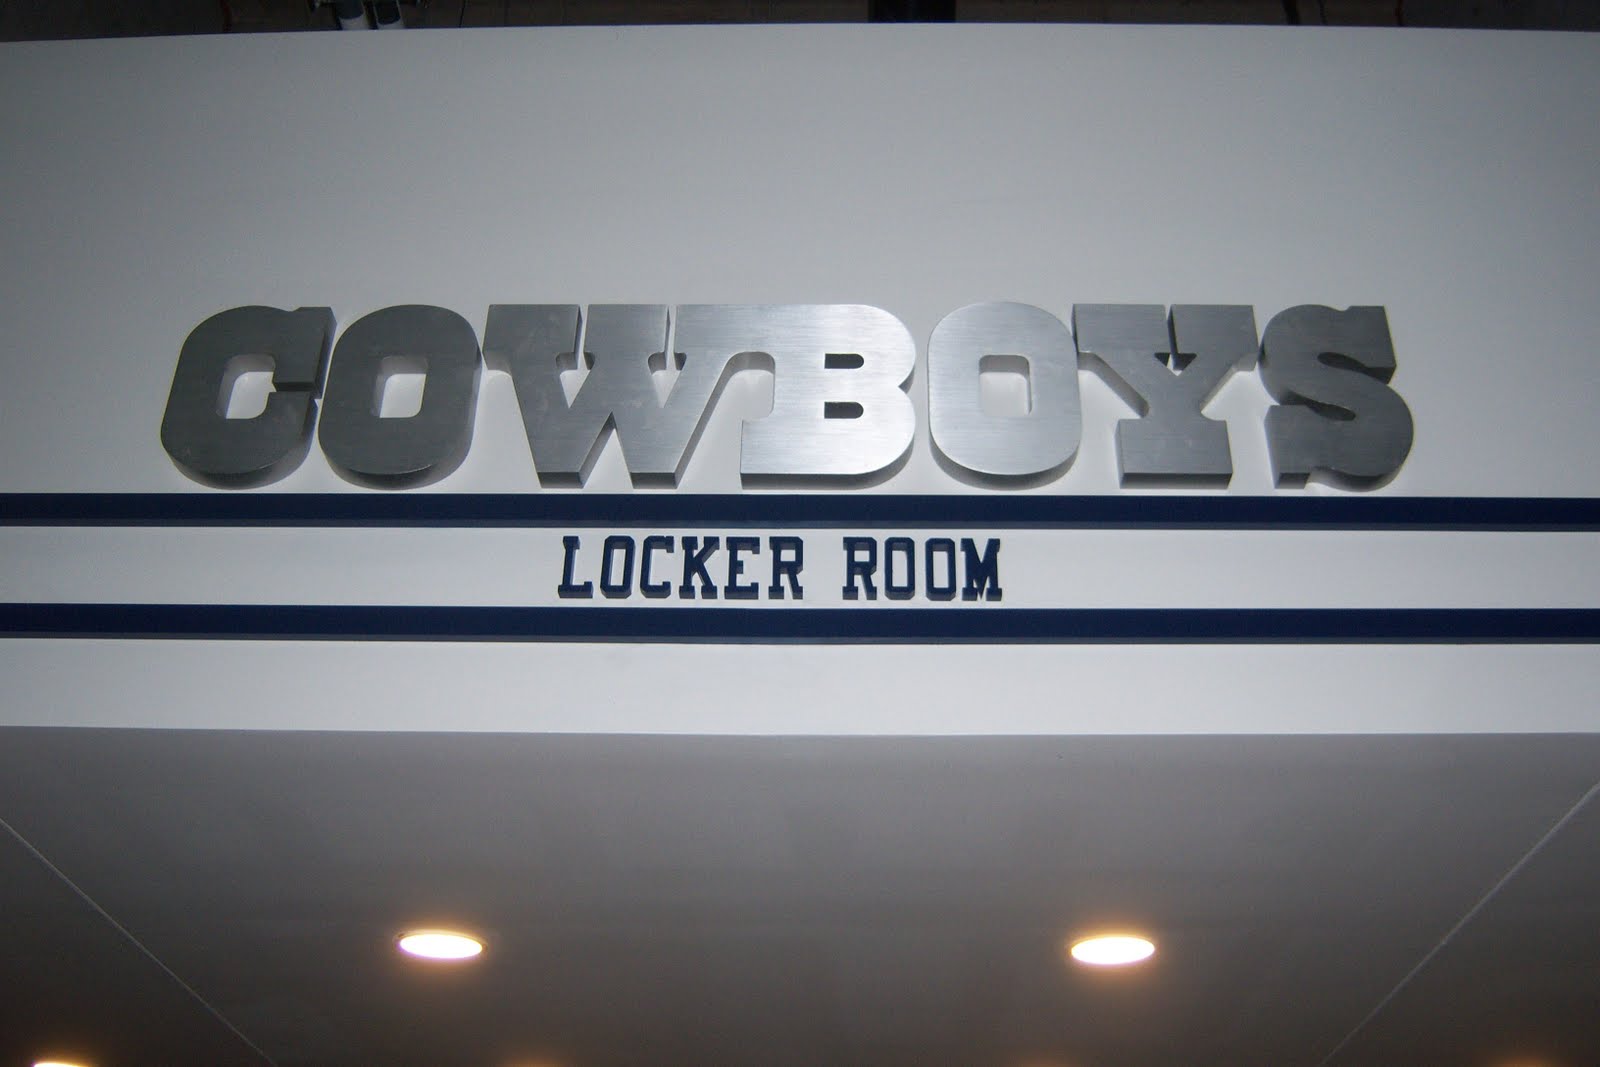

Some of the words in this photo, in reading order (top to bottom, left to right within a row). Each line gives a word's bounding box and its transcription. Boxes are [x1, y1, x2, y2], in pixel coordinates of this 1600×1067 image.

[160, 302, 1415, 490] COWBOYS
[557, 535, 804, 600] LOCKER
[842, 536, 1003, 602] ROOM
